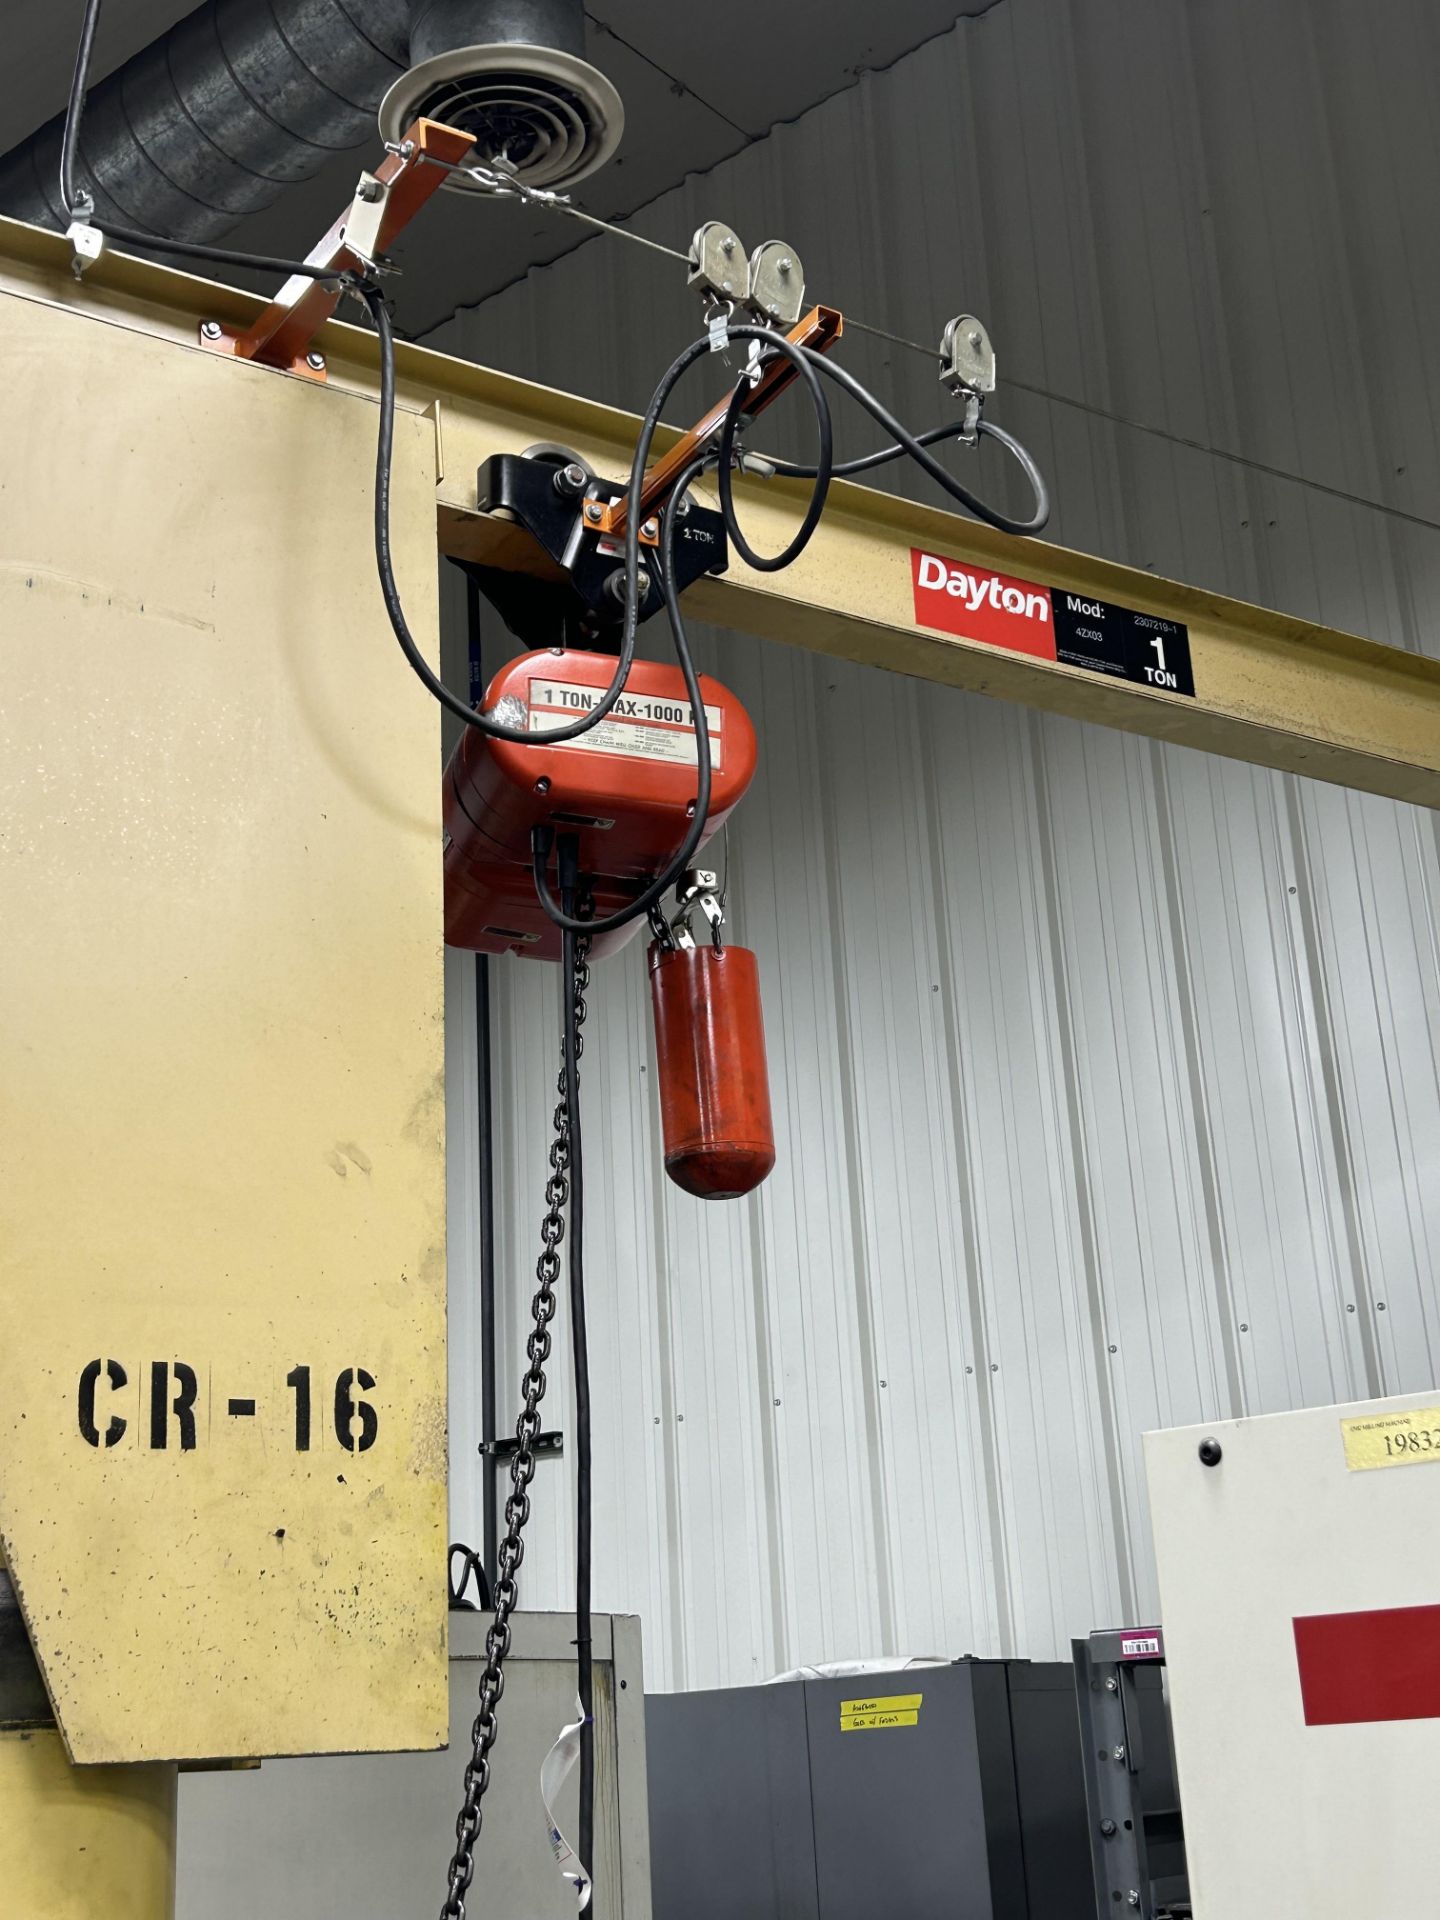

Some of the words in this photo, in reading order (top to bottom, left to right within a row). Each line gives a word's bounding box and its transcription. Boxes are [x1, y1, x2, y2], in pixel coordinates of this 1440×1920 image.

[917, 554, 1049, 622] Dayton
[1066, 595, 1106, 619] Mod:
[1149, 636, 1167, 671] 1
[1144, 666, 1177, 688] TON
[543, 688, 554, 704] 1
